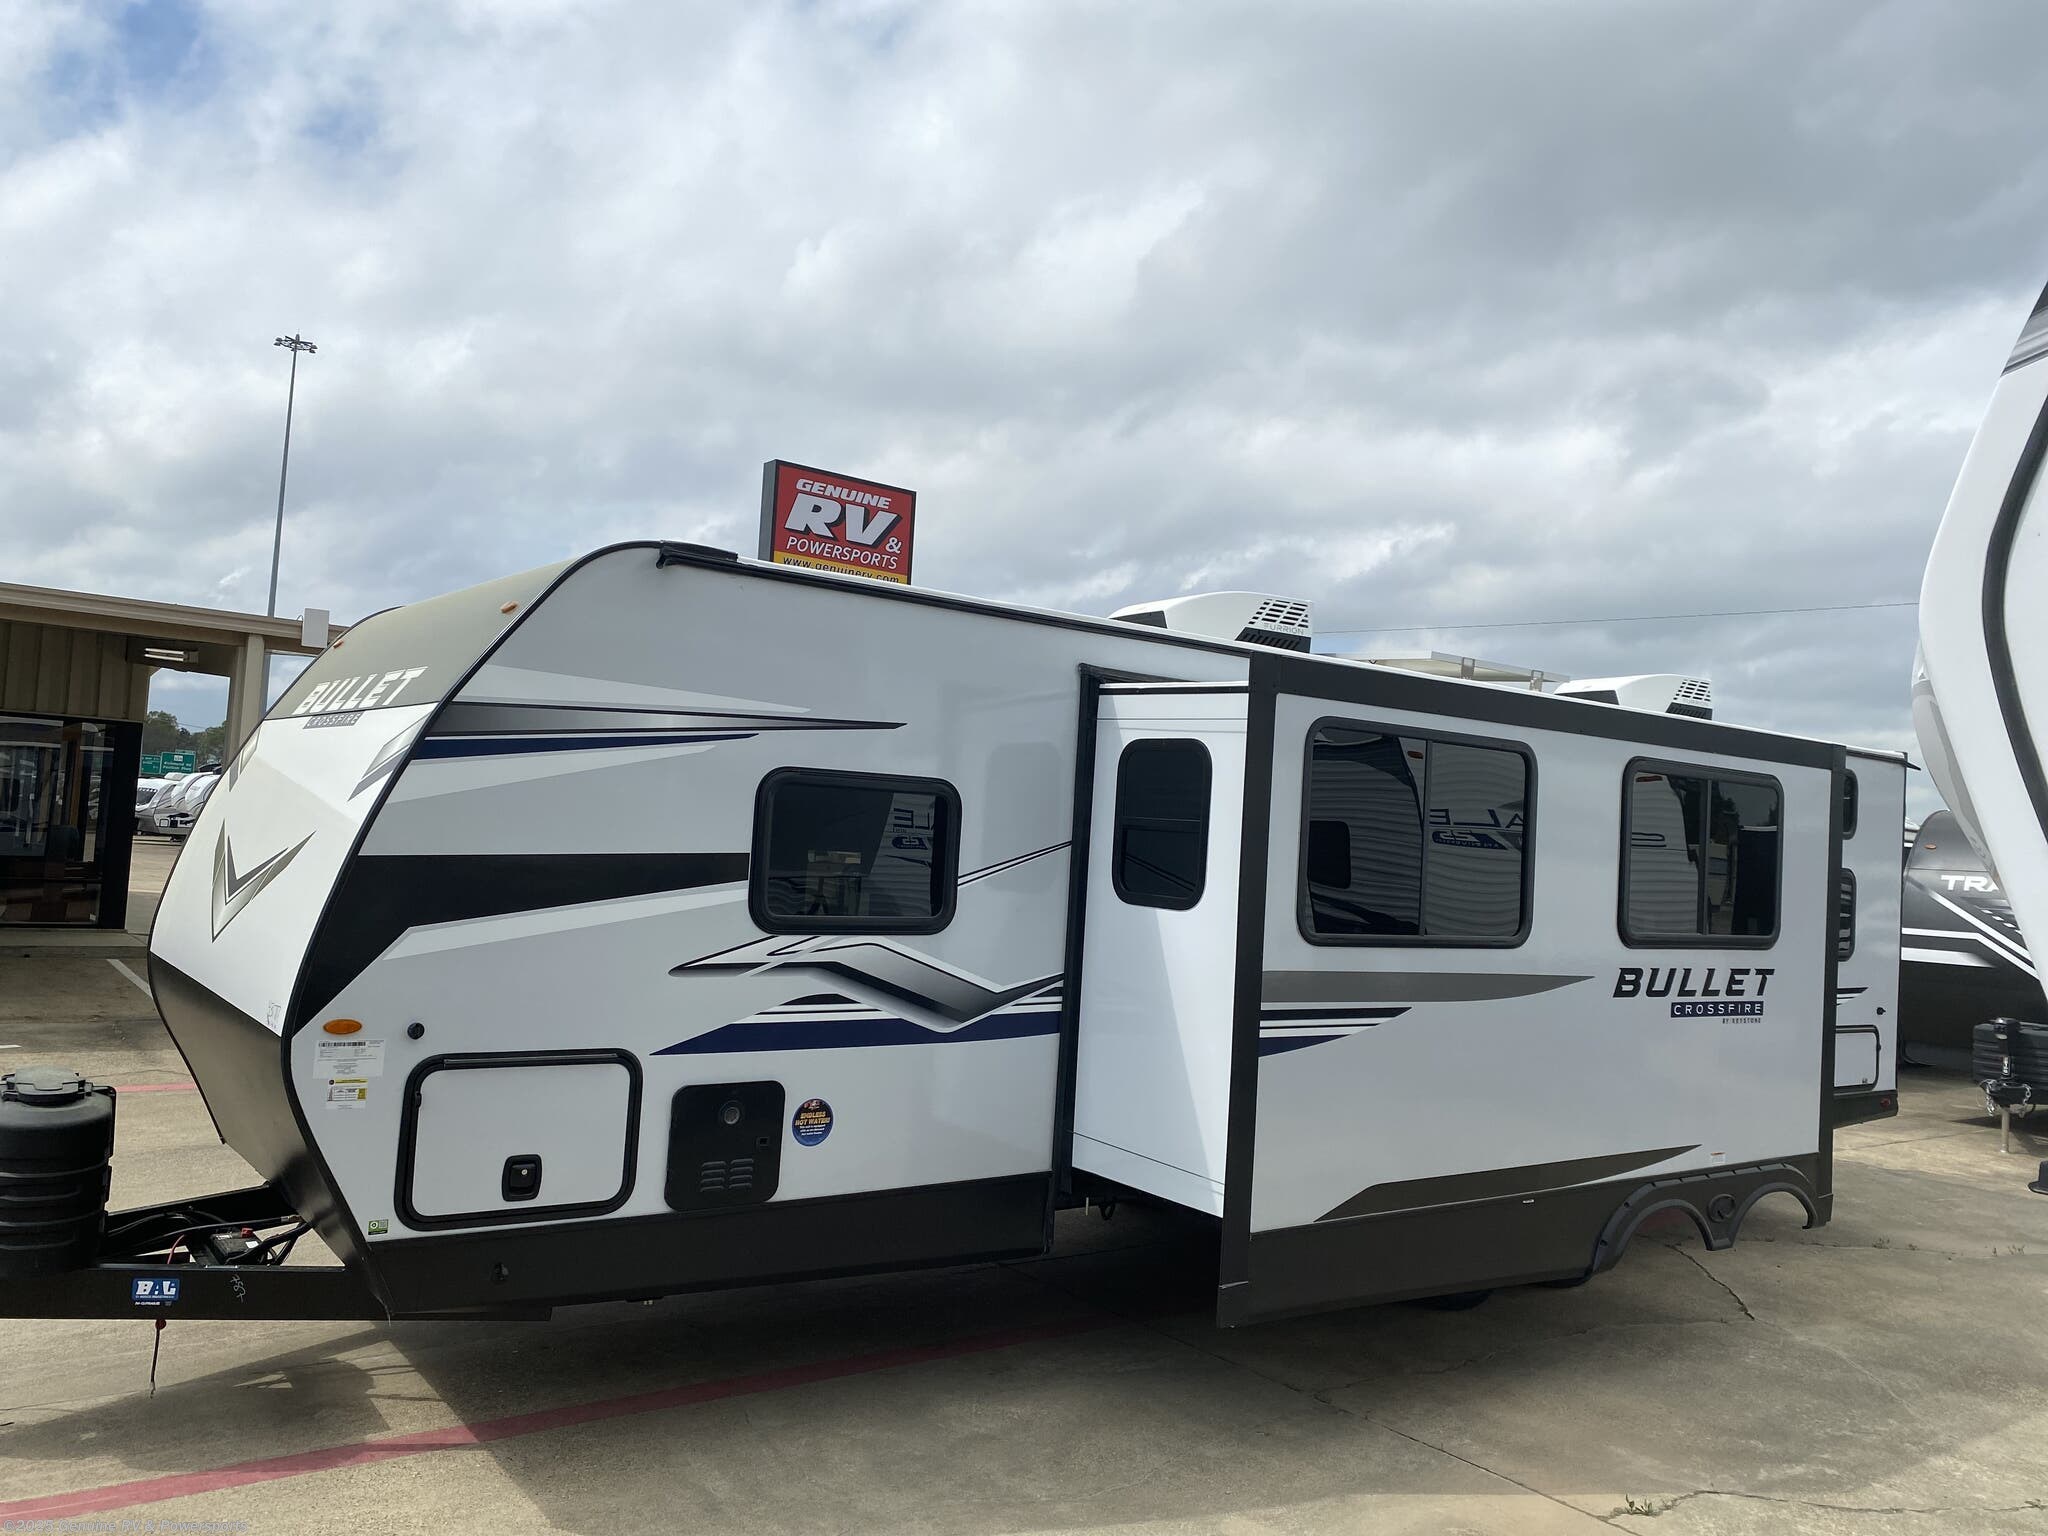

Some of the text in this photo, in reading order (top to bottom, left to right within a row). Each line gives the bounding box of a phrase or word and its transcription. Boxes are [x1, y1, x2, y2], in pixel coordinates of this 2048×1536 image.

[795, 478, 892, 509] GENUINE
[784, 492, 901, 554] RV &
[786, 536, 898, 570] POWERSPORTS
[1263, 622, 1304, 635] FURRION
[291, 666, 428, 715] BULLET
[306, 712, 361, 727] CROSSFIRE
[1612, 967, 1775, 998] BULLET
[1673, 1003, 1761, 1015] CROSSFIRE
